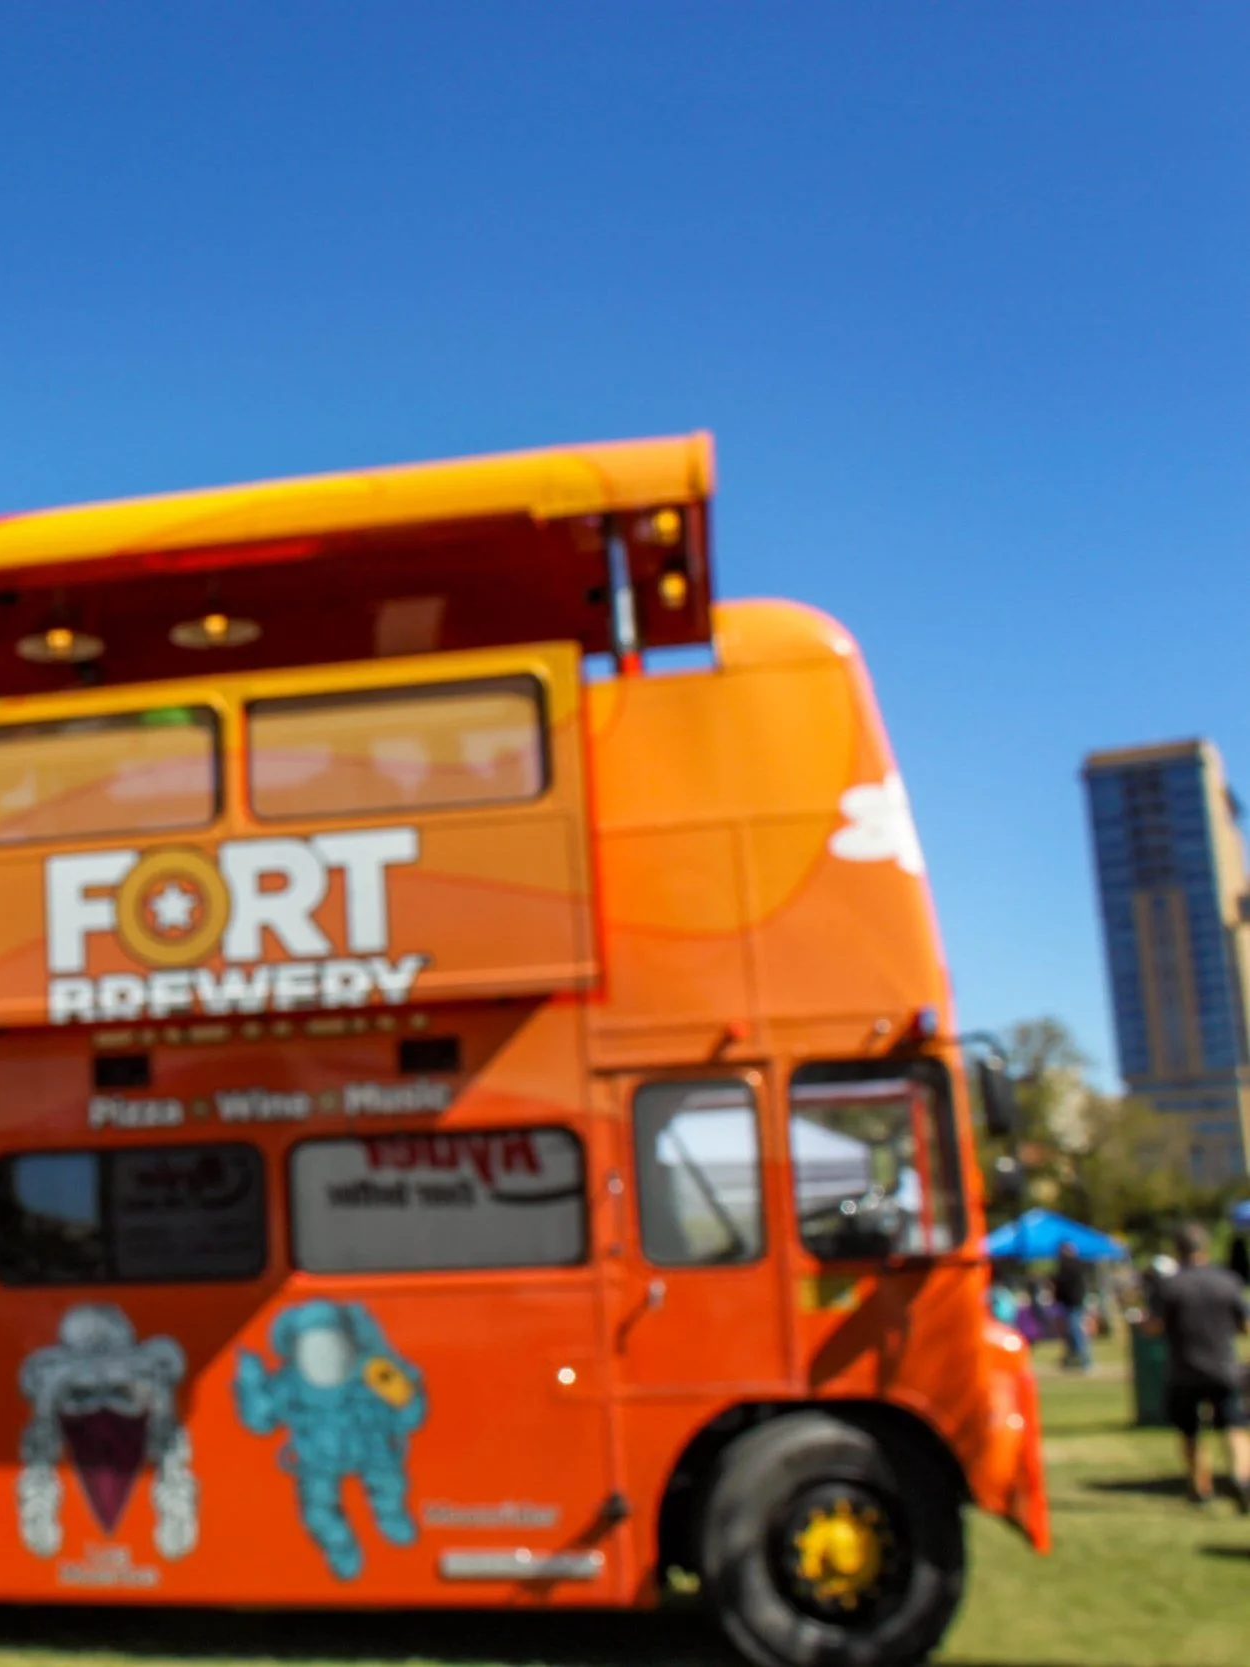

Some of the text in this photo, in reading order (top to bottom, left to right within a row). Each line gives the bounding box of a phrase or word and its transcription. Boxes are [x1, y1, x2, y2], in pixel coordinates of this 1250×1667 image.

[46, 828, 418, 973] FORT
[89, 1078, 453, 1129] Pizza Wine Music
